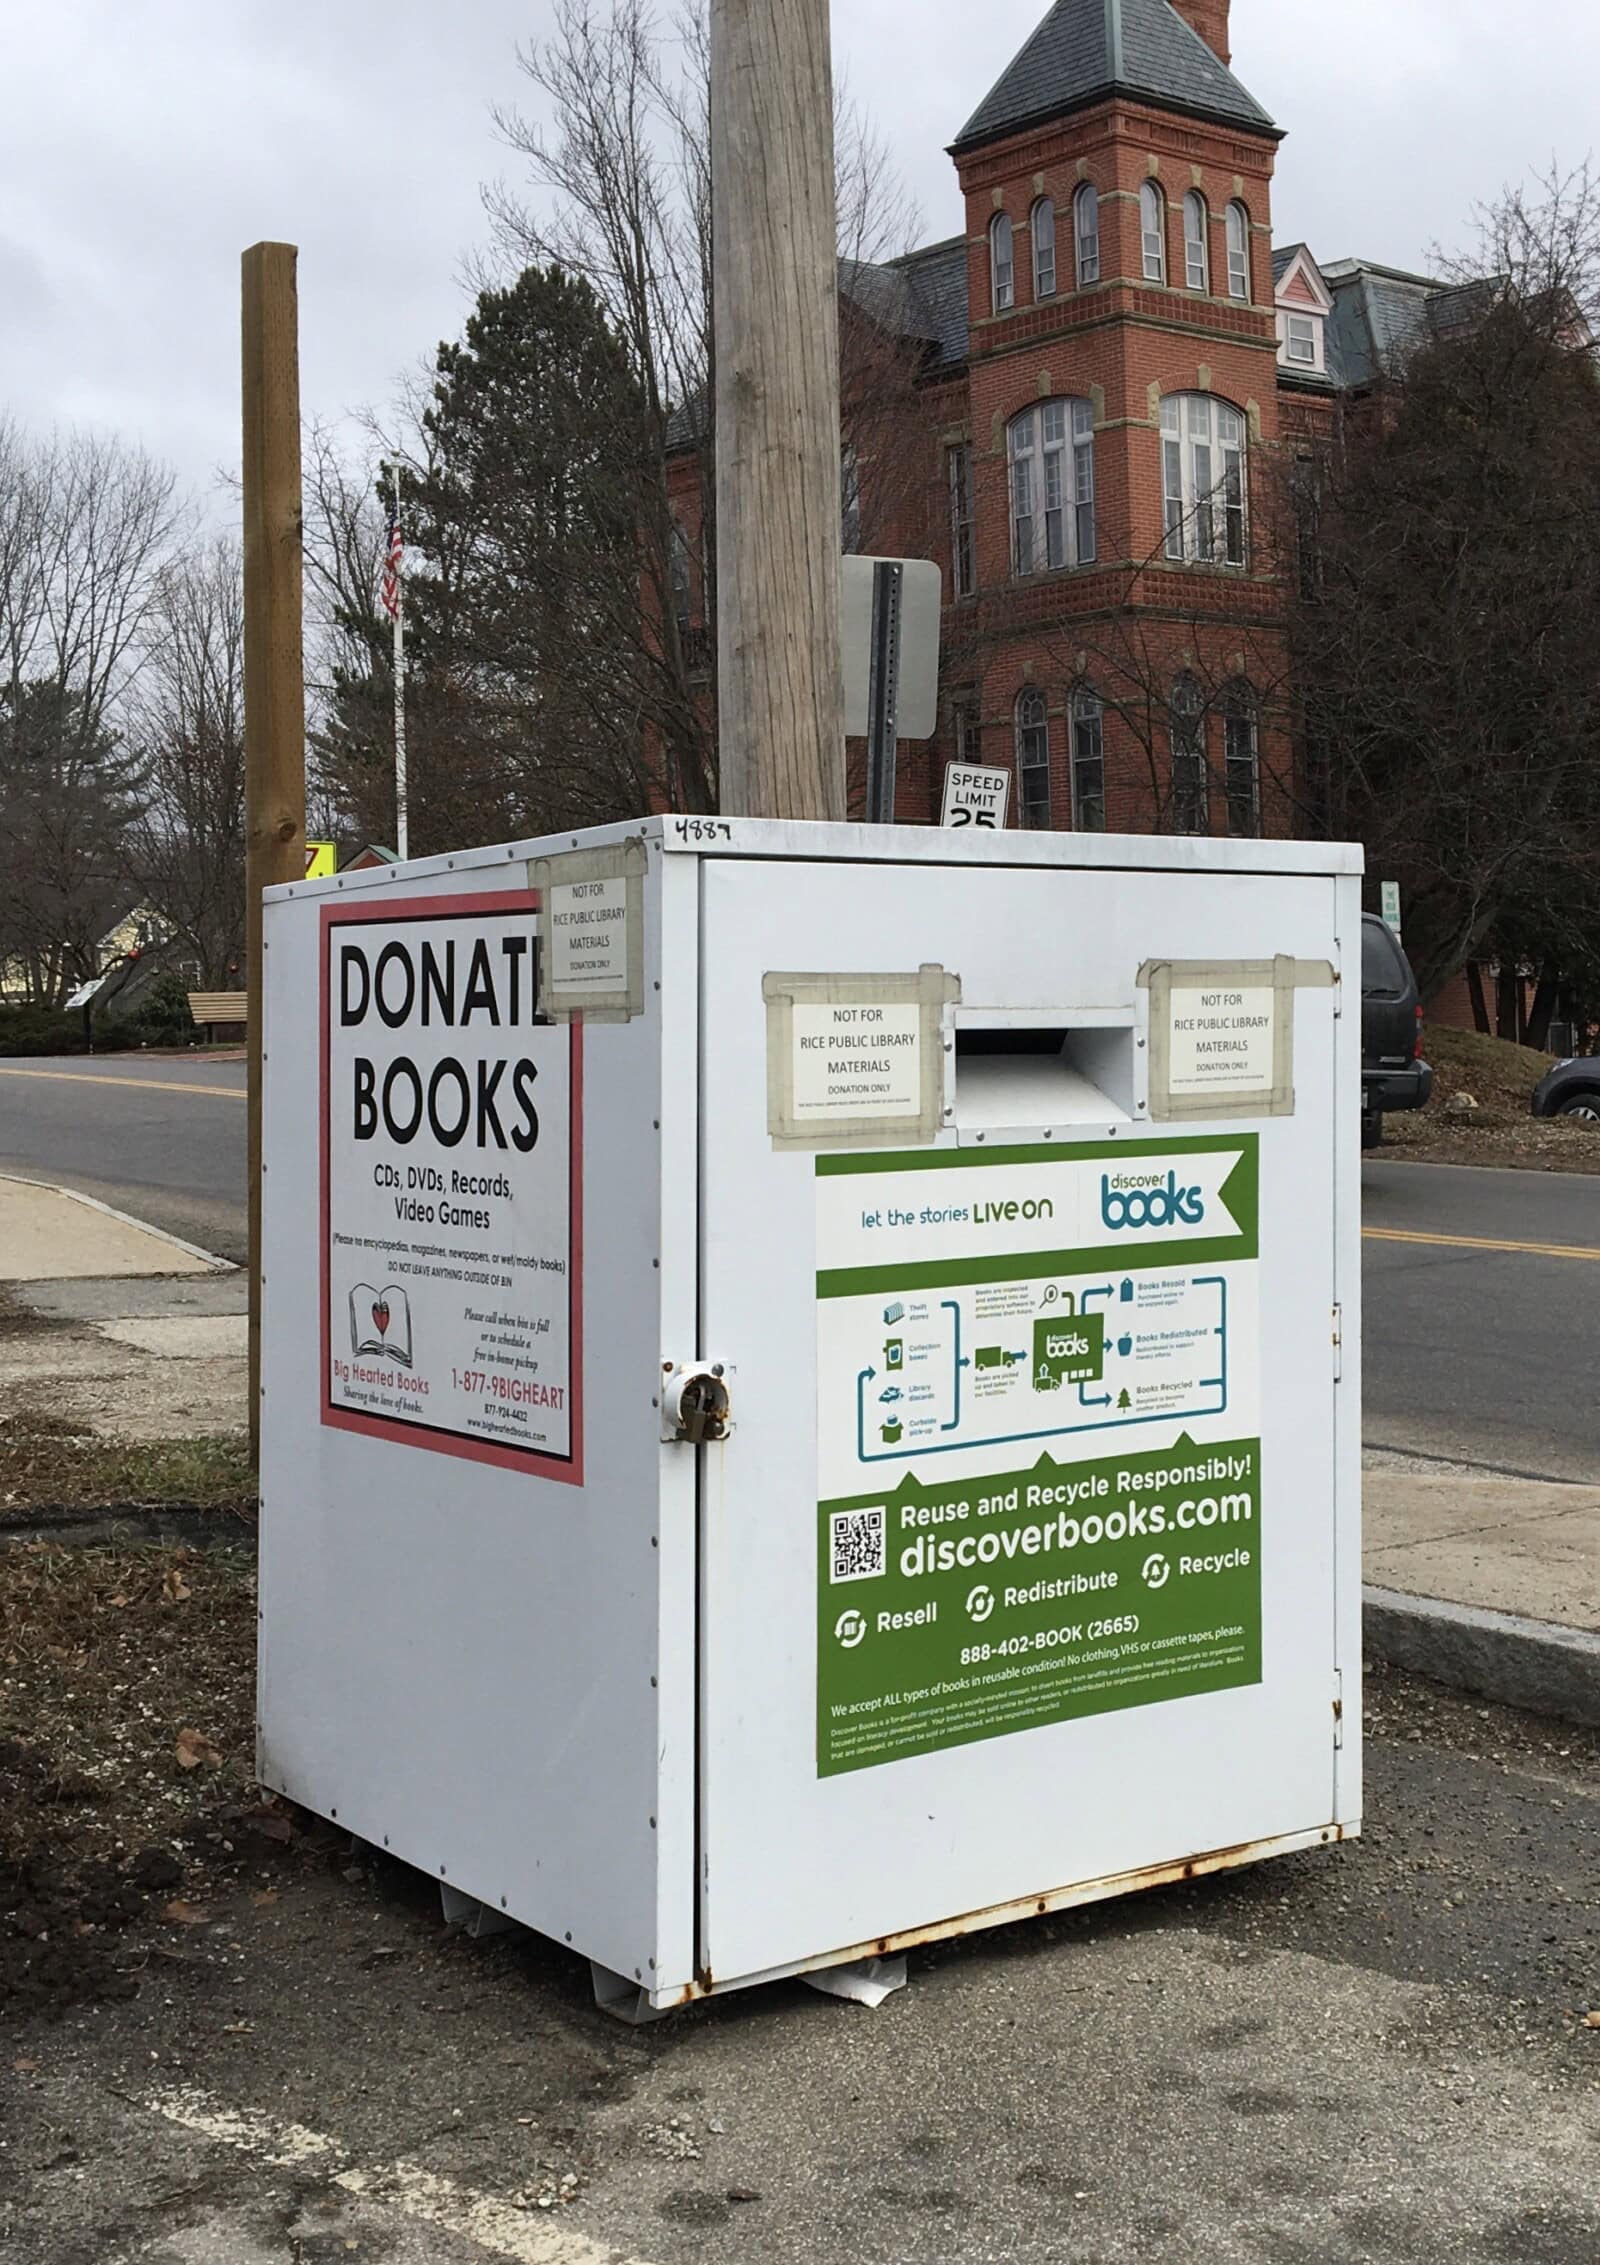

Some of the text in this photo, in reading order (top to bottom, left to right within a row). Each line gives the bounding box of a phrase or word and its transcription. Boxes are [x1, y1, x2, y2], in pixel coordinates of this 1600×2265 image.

[952, 772, 1004, 791] SPEED
[955, 791, 997, 807] LIMIT
[950, 808, 997, 830] 25
[675, 818, 731, 844] 4887
[572, 883, 604, 898] NOT FOR
[553, 907, 625, 926] RICE PUBLIC LIBRARY
[569, 935, 610, 950] MATERIALS
[1201, 994, 1243, 1006] NOT FOR
[833, 1009, 883, 1023] NOT FOR
[1174, 1016, 1269, 1031] RICE PUBLIC LIBRARY
[801, 1034, 916, 1049] RICE PUBLIC LIBRARY
[1196, 1040, 1249, 1053] MATERIALS
[827, 1060, 891, 1074] MATERIALS
[1196, 1061, 1249, 1072] DONATION ONLY
[828, 1084, 891, 1095] DONATION ONLY
[354, 1056, 540, 1153] BOOKS
[374, 1163, 513, 1201] CDs, DVDs, Records,
[1111, 1173, 1166, 1189] discover
[1101, 1169, 1204, 1230] books
[395, 1197, 491, 1229] Video Games
[861, 1210, 882, 1228] let
[887, 1209, 915, 1226] the
[920, 1205, 969, 1225] stories
[388, 1261, 512, 1287] DO NOT LEAVE ANYTHING OUTSIDE OF BIN
[492, 1254, 500, 1263] or
[540, 1257, 566, 1275] books)
[1138, 1282, 1160, 1291] Books
[464, 1307, 550, 1334] Please call when bin is full
[481, 1332, 531, 1349] or to schedule a
[1046, 1332, 1089, 1358] books
[1136, 1328, 1208, 1343] Books Redistributed
[909, 1342, 941, 1351] Collection
[334, 1360, 430, 1395] Big Hearted Books
[1136, 1380, 1193, 1394] Books Recycled
[452, 1368, 564, 1410] 1-877-9BIGHEART
[909, 1384, 931, 1394] Library
[901, 1453, 1251, 1529] Reuse and Recycle Responsibly!
[900, 1492, 1252, 1577] discoverbooks.com
[1179, 1547, 1251, 1575] Recycle
[1004, 1570, 1119, 1608] Redistribute
[877, 1601, 937, 1632] Resell
[960, 1614, 1140, 1665] 888-402-BOOK (2665)
[831, 1625, 1245, 1718] We accept ALL types of books in reusable condition! No clothing, VHS or cassette tapes, please.
